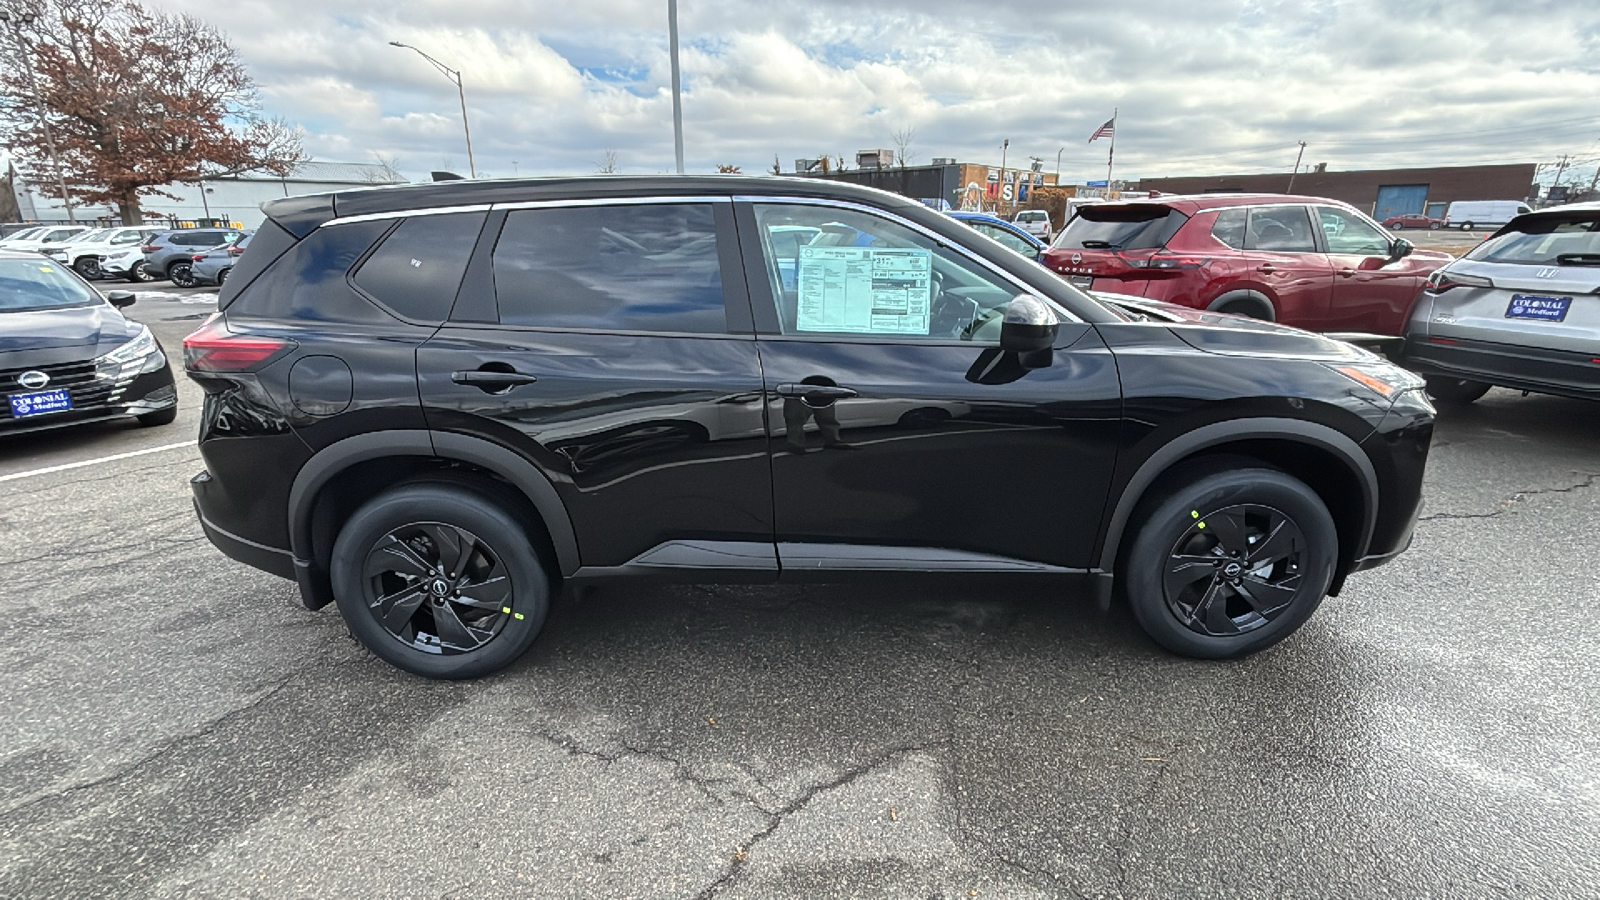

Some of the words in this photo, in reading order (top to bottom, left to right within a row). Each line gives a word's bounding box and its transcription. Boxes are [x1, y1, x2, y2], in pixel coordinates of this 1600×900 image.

[1513, 299, 1565, 309] COLONIAL
[1526, 307, 1560, 316] Medford
[12, 393, 68, 406] COLONIAL
[33, 400, 68, 411] Medford
